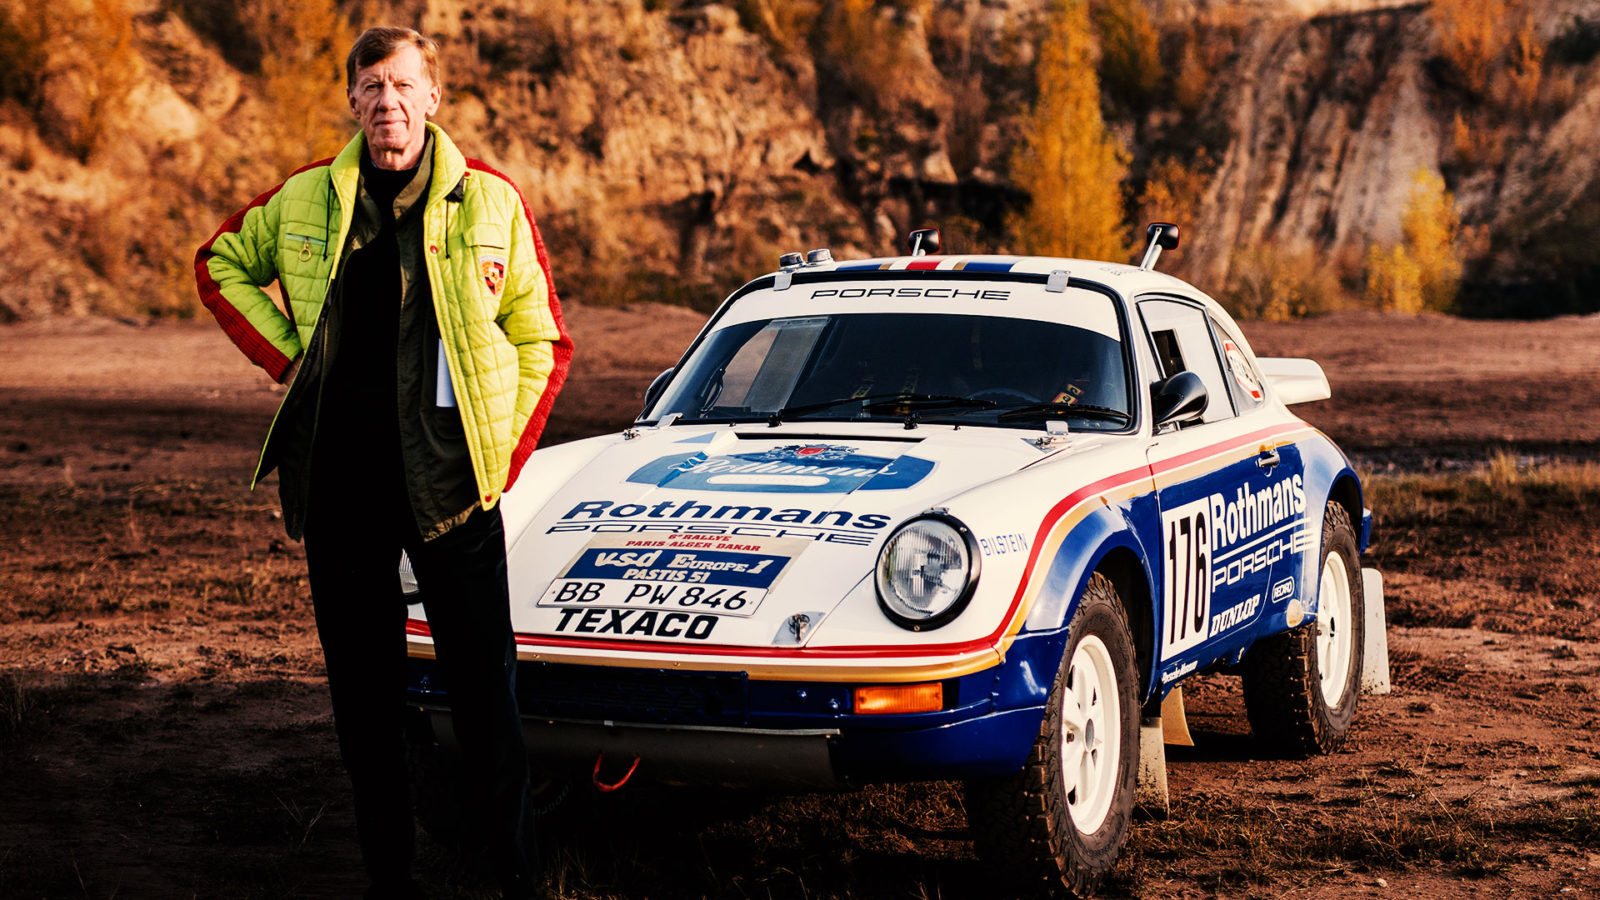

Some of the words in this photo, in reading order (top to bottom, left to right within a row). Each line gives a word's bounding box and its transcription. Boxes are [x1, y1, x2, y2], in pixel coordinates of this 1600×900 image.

[811, 288, 1011, 300] PORSCHE
[561, 500, 892, 529] Rothmans
[1210, 474, 1307, 552] Rothmans
[545, 524, 875, 546] PORSCHE
[980, 533, 1028, 556] BILSTEIN
[746, 559, 774, 574] 1
[1212, 528, 1318, 594] PORSCHE
[622, 568, 688, 581] PASTIS
[688, 572, 711, 583] 51
[1169, 511, 1207, 645] 176
[554, 582, 606, 603] BB
[624, 584, 678, 604] PW
[678, 587, 748, 610] 846
[555, 608, 719, 640] TEXACO
[1209, 594, 1261, 639] DUNLOP
